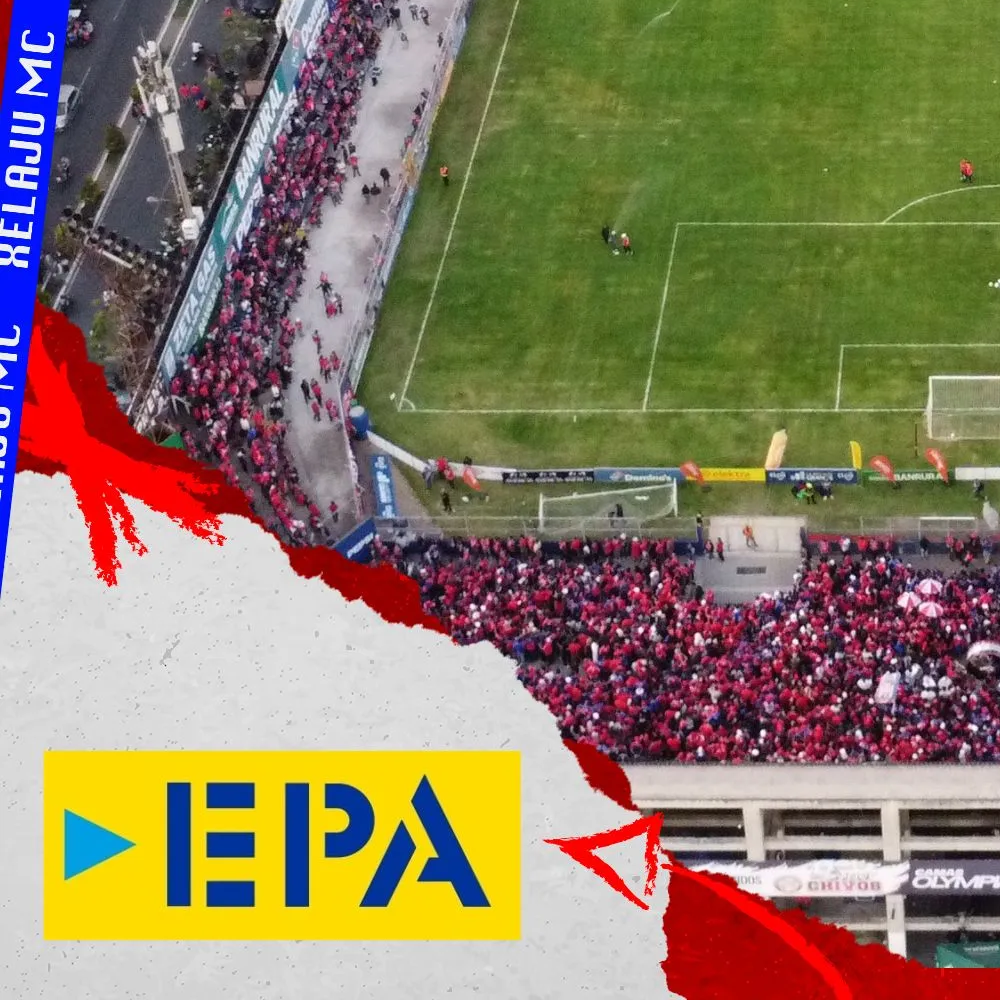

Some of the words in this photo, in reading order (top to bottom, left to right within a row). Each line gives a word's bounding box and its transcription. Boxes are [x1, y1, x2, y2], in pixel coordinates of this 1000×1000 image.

[235, 79, 284, 200] BANRURAL
[172, 293, 199, 352] ZETA
[197, 244, 216, 293] GAS
[624, 473, 672, 483] Domino's
[895, 473, 943, 481] BANRURA
[807, 881, 881, 891] CHIVOS
